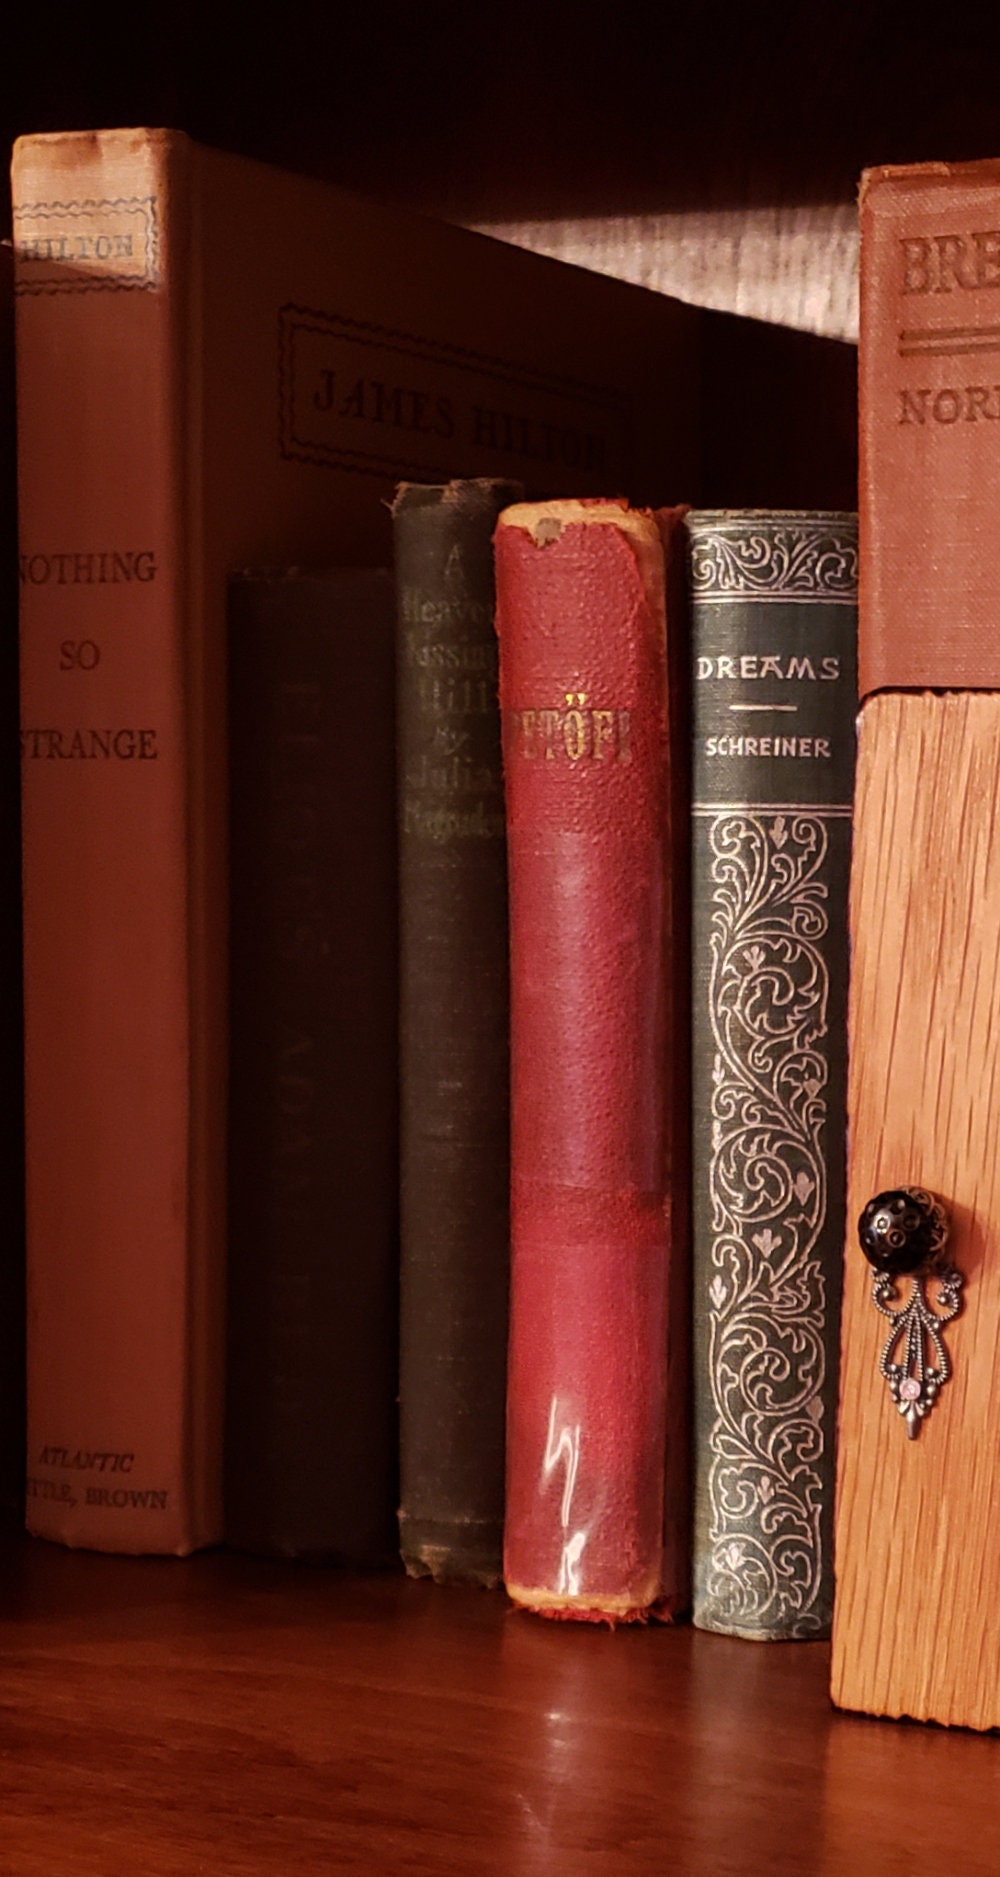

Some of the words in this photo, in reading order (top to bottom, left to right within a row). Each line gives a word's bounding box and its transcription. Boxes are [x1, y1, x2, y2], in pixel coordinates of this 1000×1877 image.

[21, 234, 134, 260] HILTON
[313, 368, 456, 439] JAMES
[471, 403, 606, 474] HILTON
[59, 639, 101, 671] SO
[696, 654, 840, 681] DREAMS
[705, 735, 831, 758] SCHREINER
[38, 1444, 135, 1473] ATLANTIC
[85, 1487, 169, 1510] BROWN
